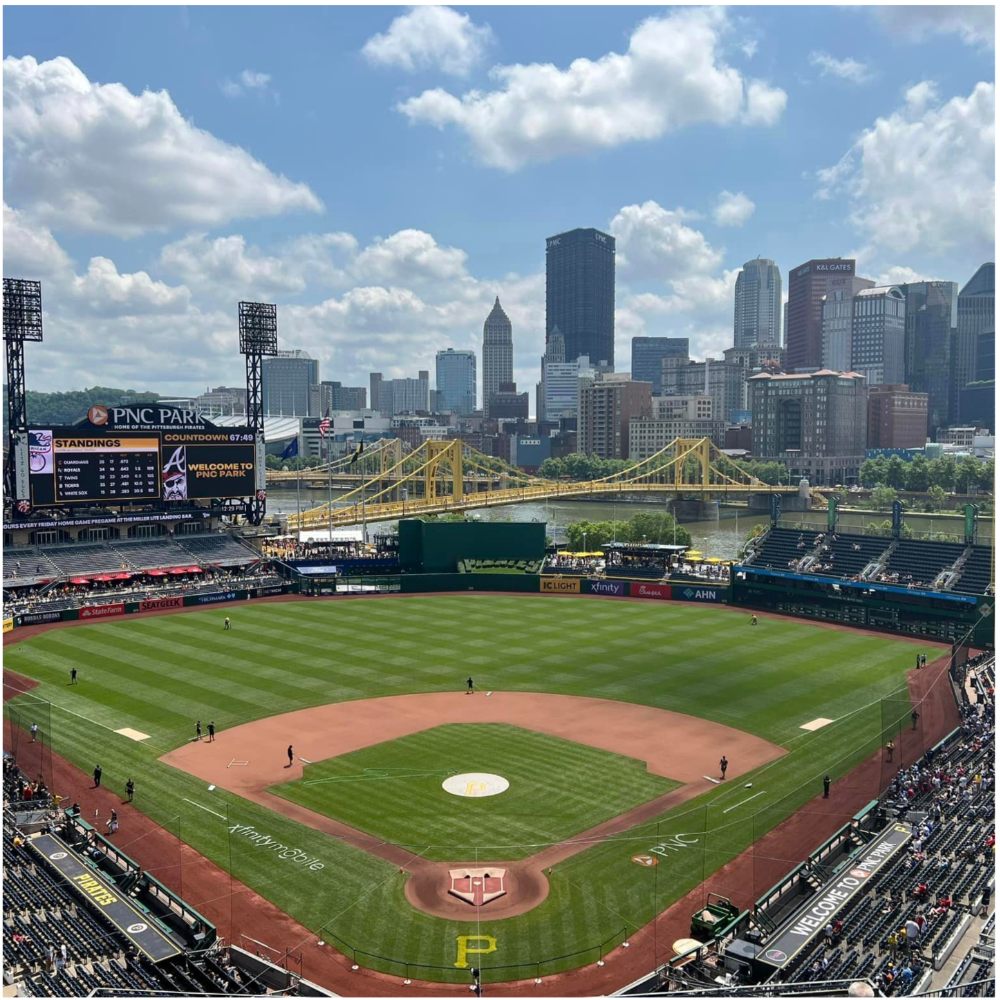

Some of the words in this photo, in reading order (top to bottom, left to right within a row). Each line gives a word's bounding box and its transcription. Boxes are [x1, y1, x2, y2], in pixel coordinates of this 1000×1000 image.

[111, 408, 154, 424] PNC
[158, 408, 205, 424] PARK
[55, 439, 121, 448] STANDINGS
[164, 434, 229, 442] COUNTDOWN
[229, 434, 254, 442] 67:49
[188, 463, 239, 471] WELCOME
[196, 470, 218, 478] PNC
[219, 470, 246, 478] PARK
[543, 581, 553, 590] IC
[553, 581, 577, 590] LIGHT
[590, 580, 620, 594] xfinity
[695, 589, 716, 599] AHN
[141, 598, 181, 610] SEATGEEK
[649, 833, 699, 857] PNC
[72, 873, 118, 906] PIRATES
[789, 889, 849, 936] WELCOME
[837, 877, 860, 891] TO
[857, 855, 881, 872] PNC
[874, 840, 897, 857] PARK
[454, 935, 498, 968] P
